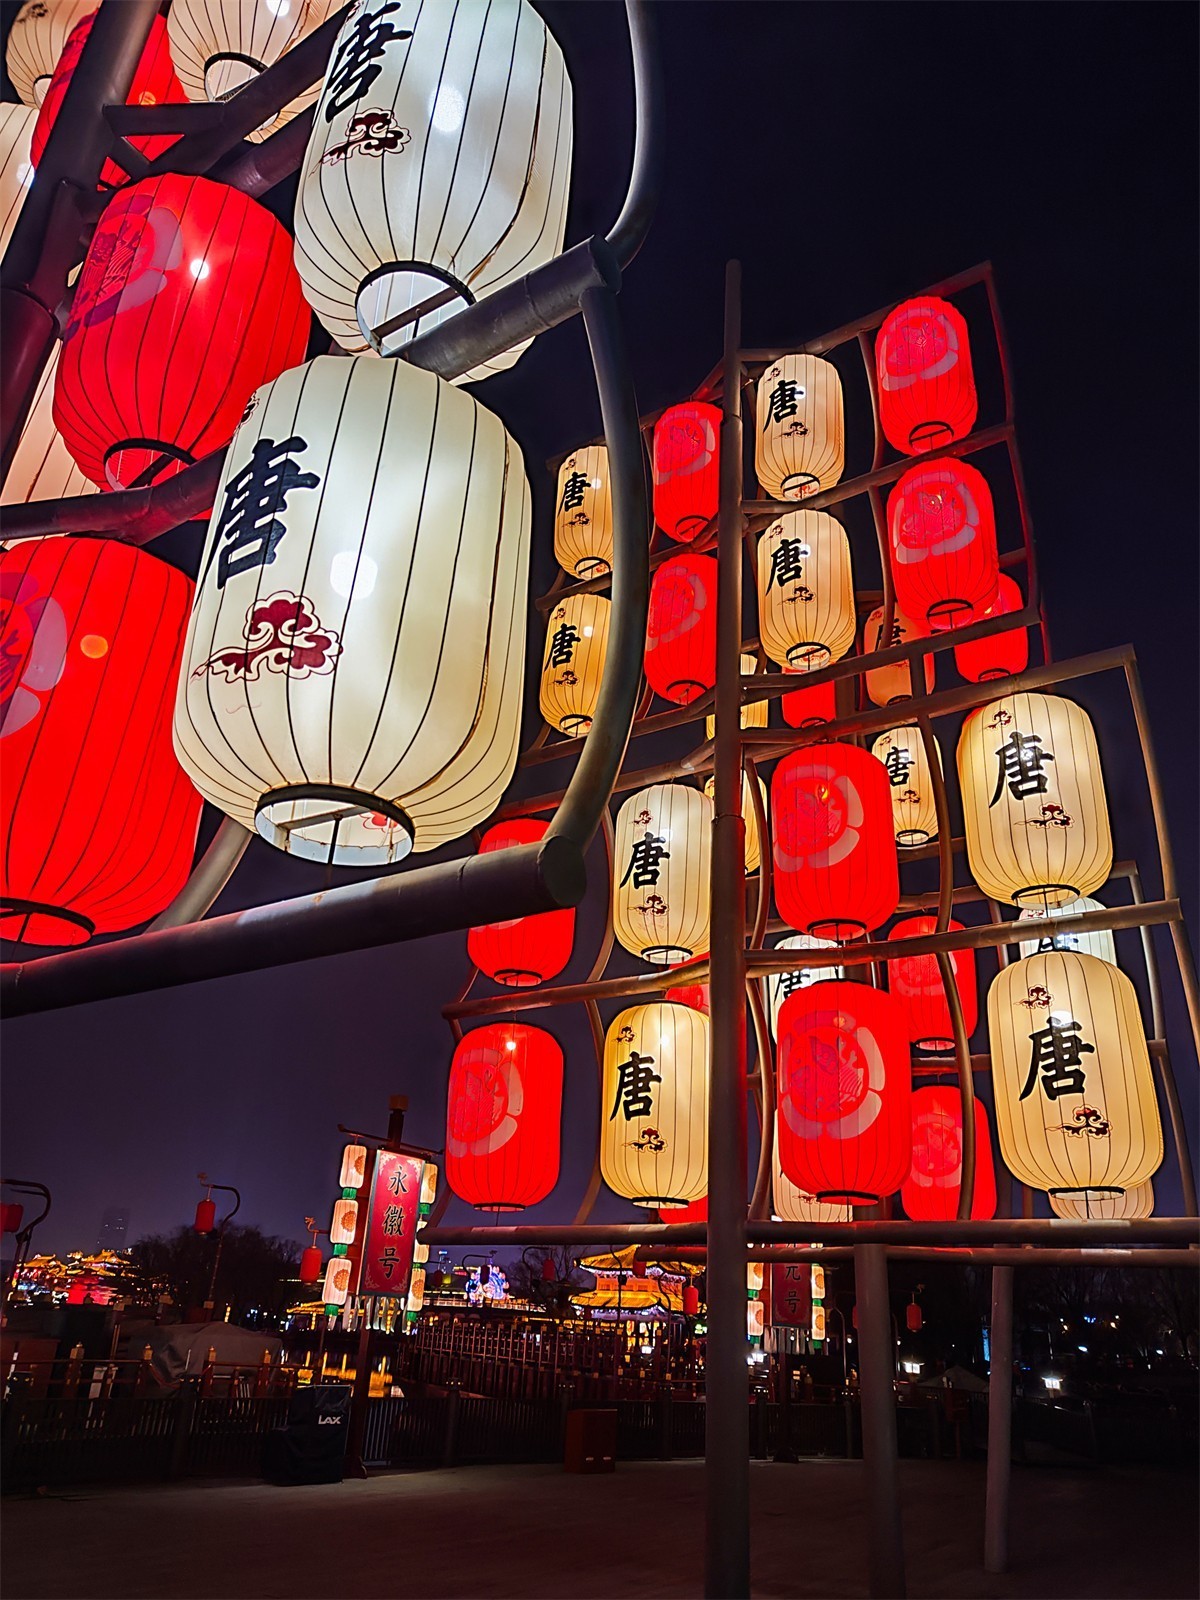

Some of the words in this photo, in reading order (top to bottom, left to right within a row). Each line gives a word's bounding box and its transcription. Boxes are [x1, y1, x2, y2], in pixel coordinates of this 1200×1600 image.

[314, 2, 413, 126] 唐
[763, 379, 803, 434] 唐
[191, 436, 321, 610] 唐
[557, 471, 592, 519] 唐
[766, 538, 809, 597] 唐
[544, 623, 581, 673] 唐
[884, 746, 915, 787] 唐
[989, 731, 1055, 809] 唐
[619, 831, 671, 890] 唐
[609, 1051, 662, 1122] 唐
[1019, 1016, 1095, 1102] 唐
[378, 1166, 408, 1279] 永徽号
[318, 1415, 341, 1425] LAX
